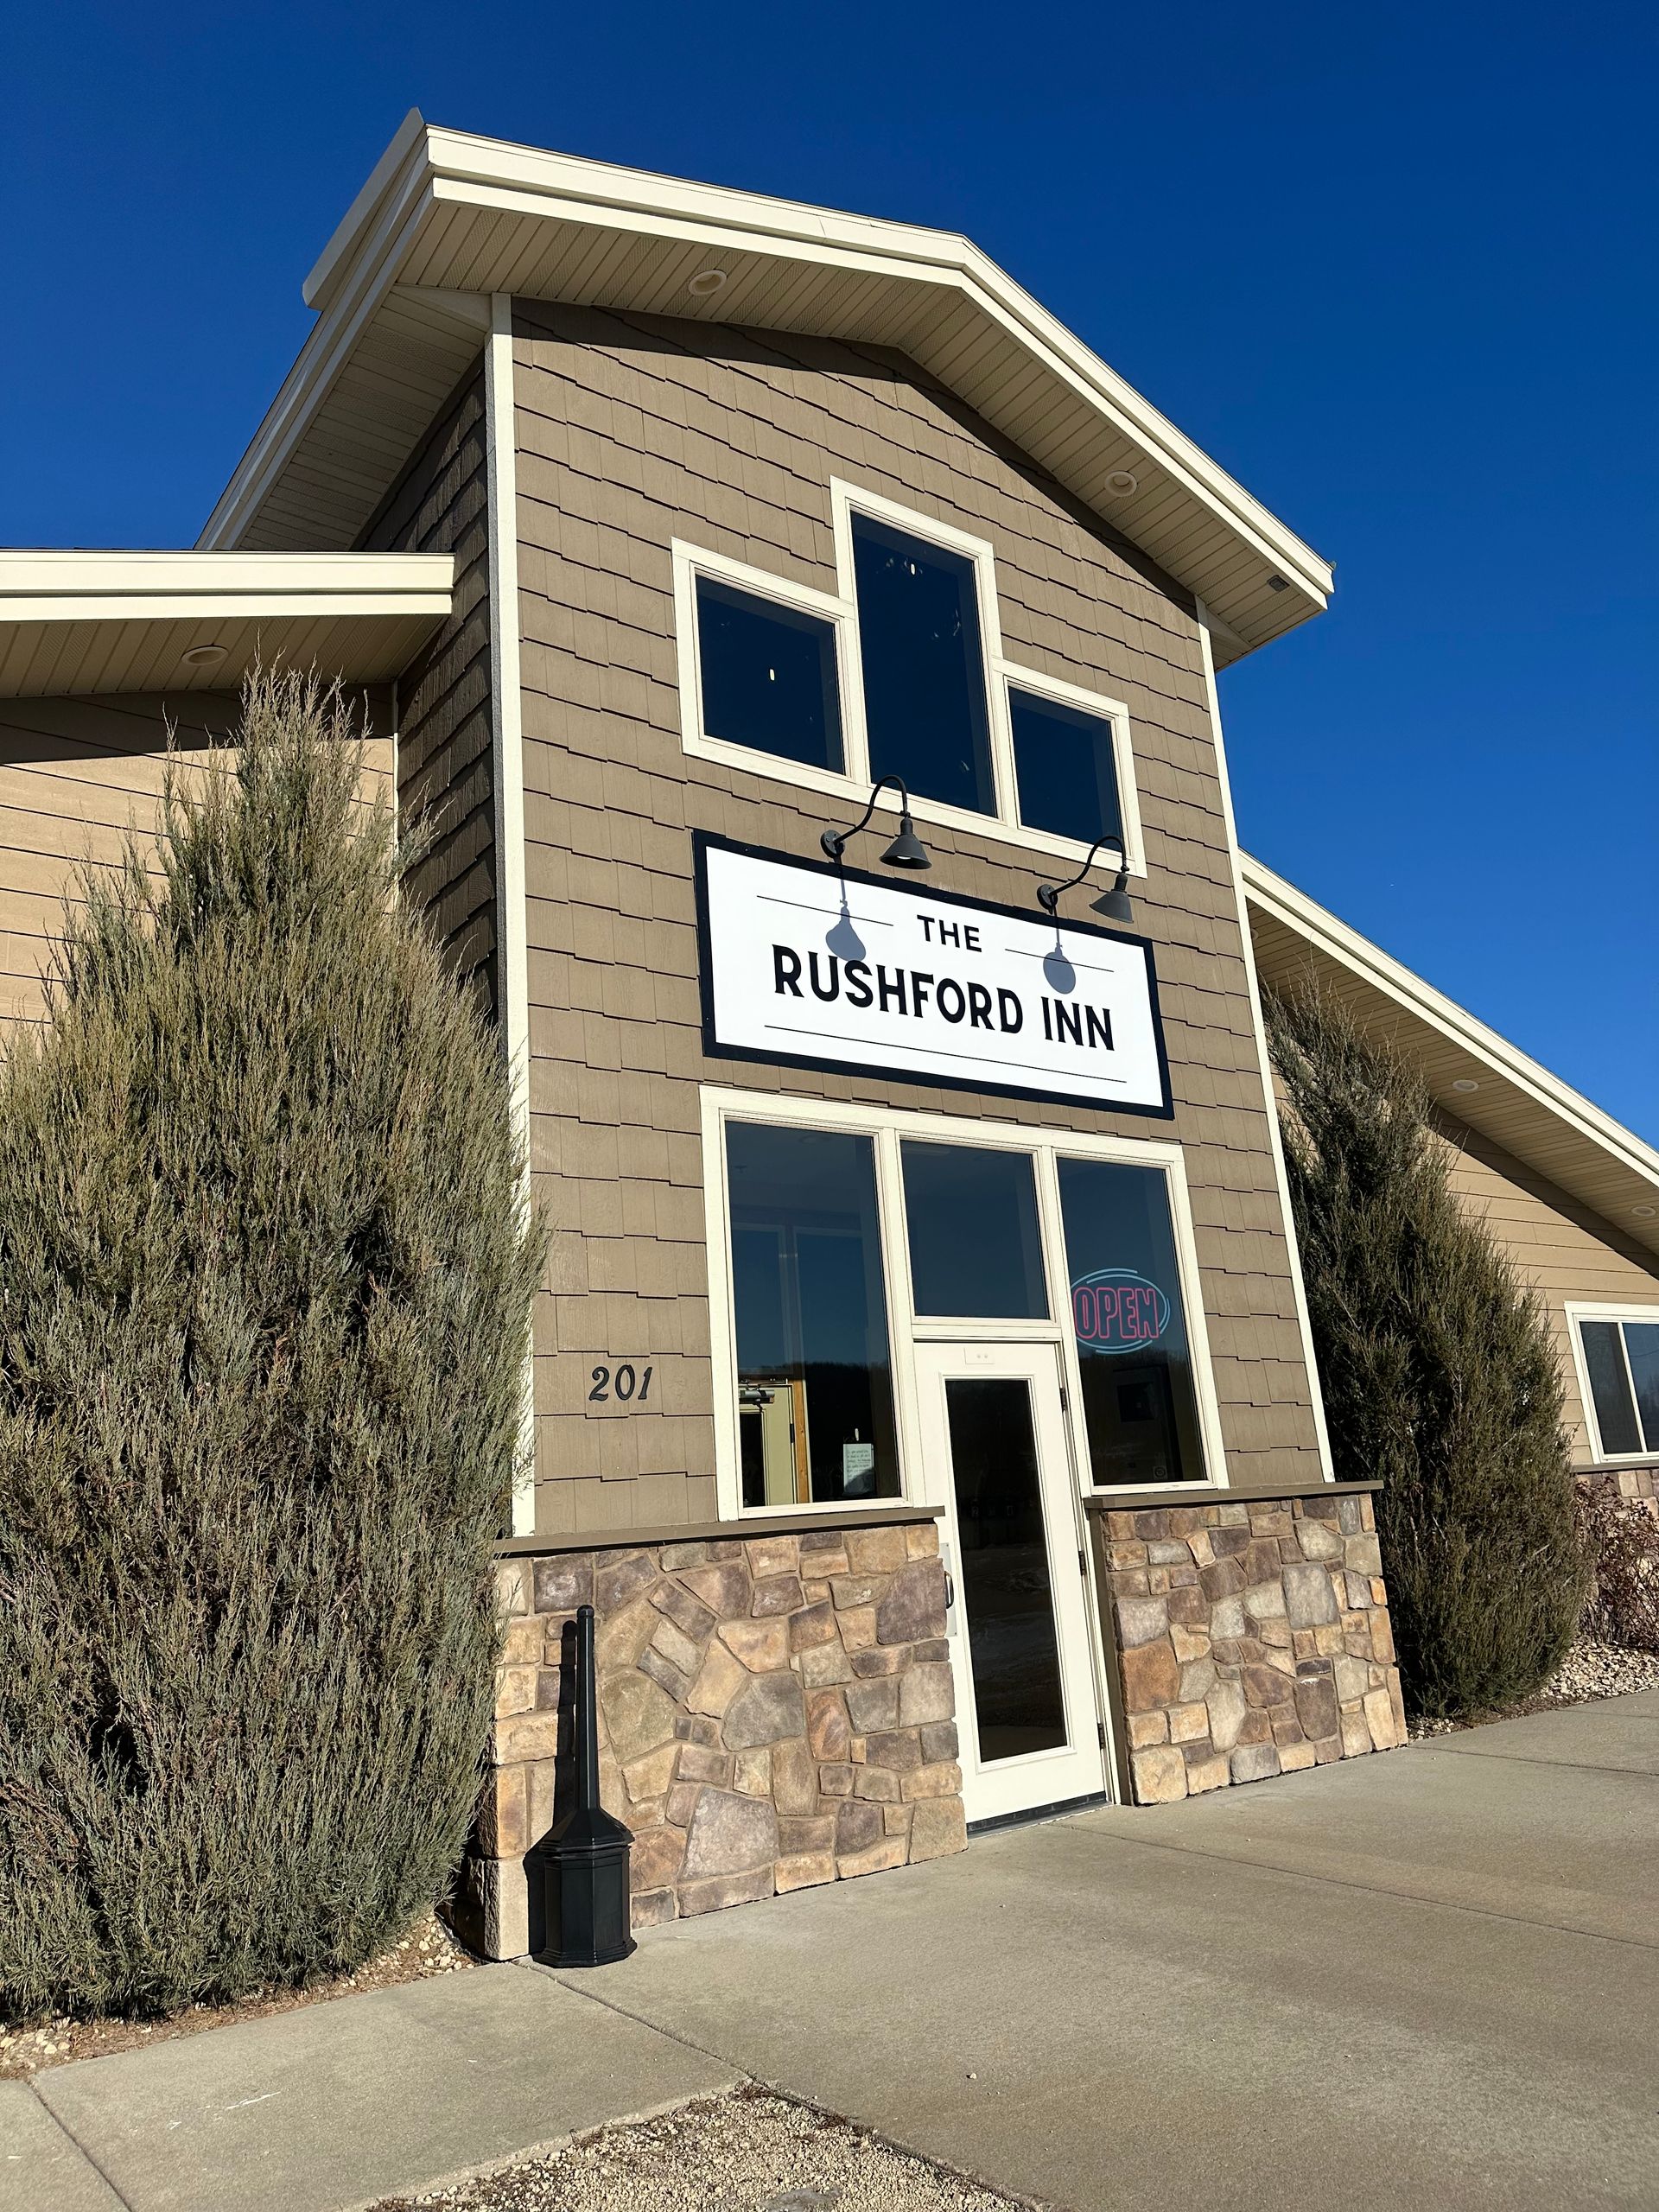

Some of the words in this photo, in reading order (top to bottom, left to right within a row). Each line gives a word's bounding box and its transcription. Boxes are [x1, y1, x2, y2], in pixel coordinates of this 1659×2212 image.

[917, 914, 982, 952] THE
[772, 944, 1023, 1034] RUSHFORD
[1041, 996, 1115, 1052] INN
[1073, 1287, 1160, 1339] OPEN
[588, 1364, 652, 1401] 201
